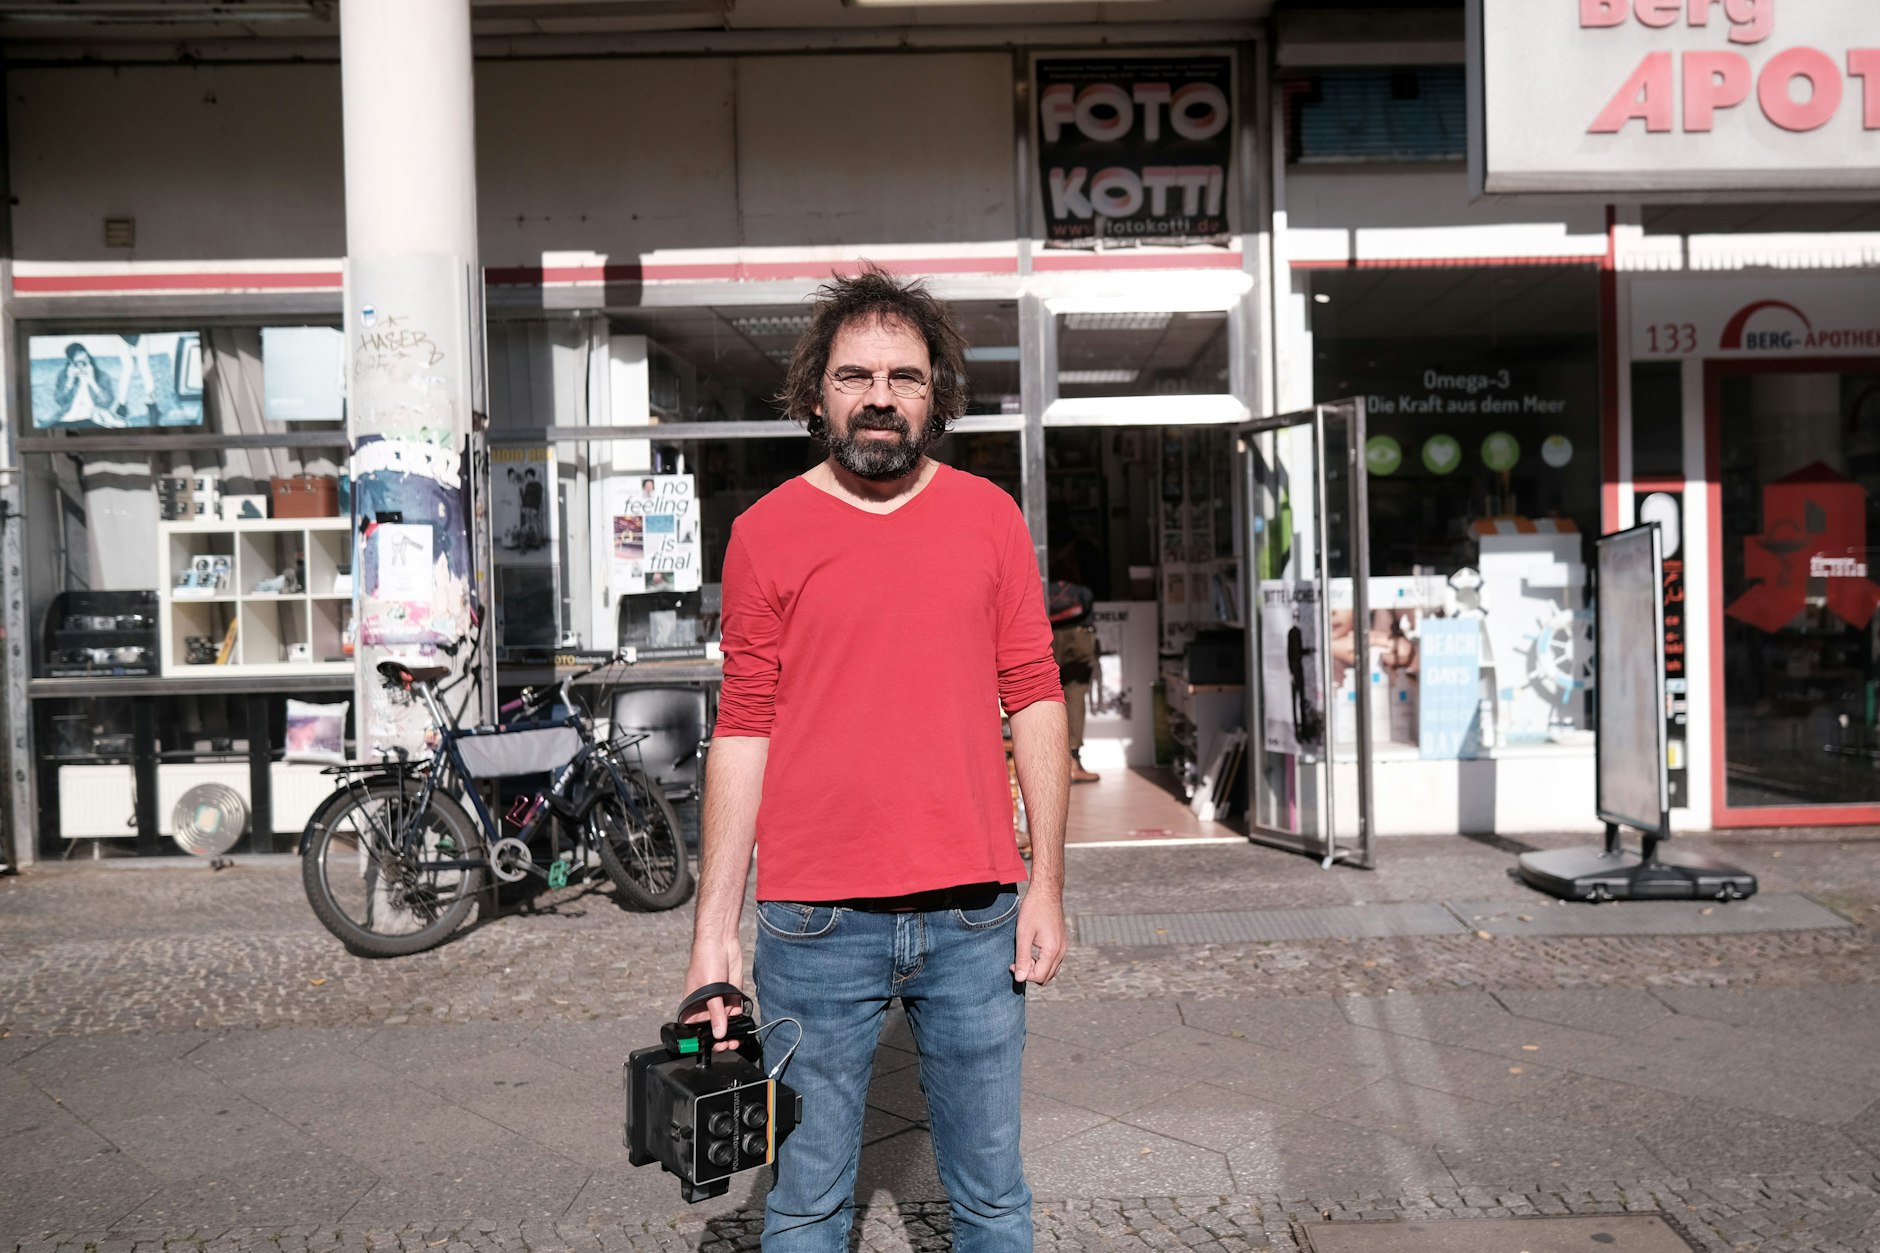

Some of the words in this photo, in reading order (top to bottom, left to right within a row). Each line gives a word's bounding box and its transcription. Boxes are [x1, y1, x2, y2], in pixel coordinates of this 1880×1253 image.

[1586, 46, 1880, 134] APOT
[1040, 81, 1230, 143] FOTO
[1048, 165, 1223, 220] KOTTI
[1052, 218, 1221, 237] wwfotokotti.de
[1646, 323, 1698, 354] 133
[1423, 369, 1511, 394] Omega-3
[1367, 395, 1395, 414] Die
[1399, 394, 1442, 414] Kraft
[1447, 399, 1476, 414] aus
[1480, 395, 1519, 414] dem
[1523, 395, 1566, 414] Meer
[663, 481, 688, 495] no
[624, 496, 689, 518] feeling
[661, 535, 676, 552] is
[650, 552, 691, 570] final
[1423, 632, 1478, 657] BEACH
[1426, 666, 1471, 687] DAYS
